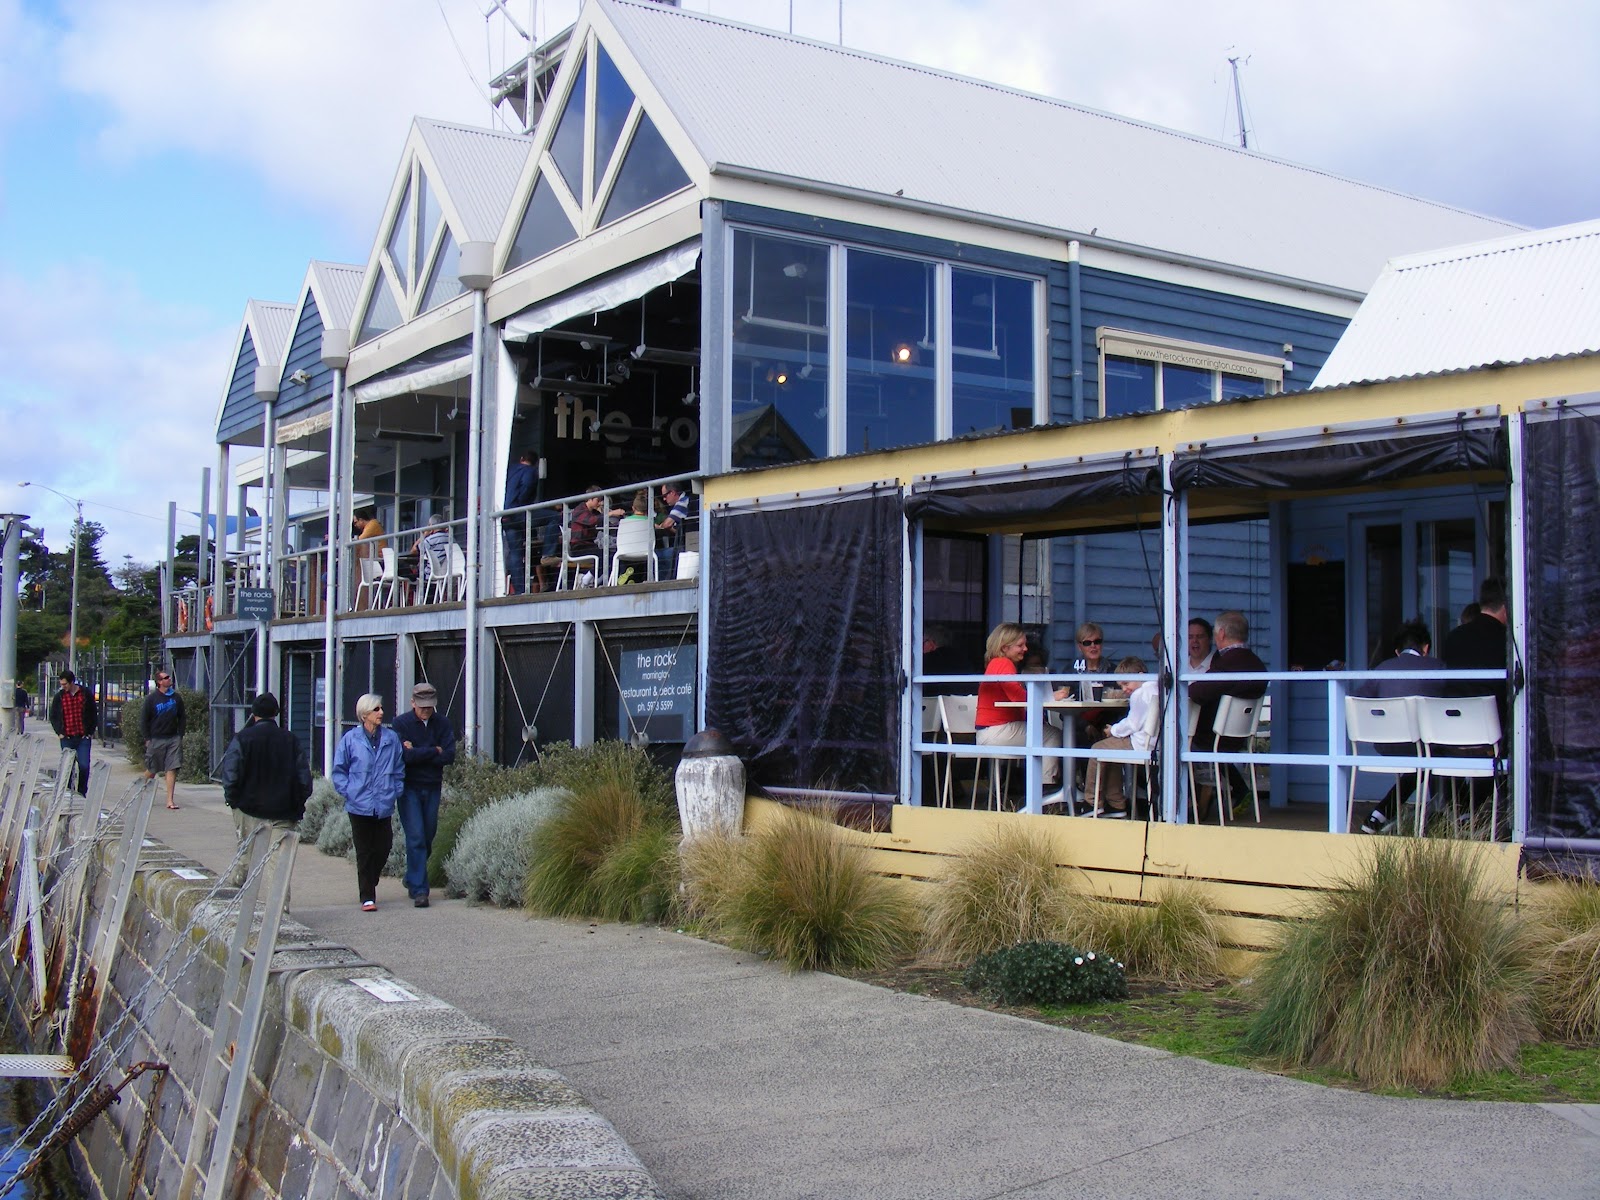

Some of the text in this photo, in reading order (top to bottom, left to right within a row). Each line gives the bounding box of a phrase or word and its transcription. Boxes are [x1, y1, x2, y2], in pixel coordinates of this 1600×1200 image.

[1134, 348, 1258, 375] www.therocksmornington.com.au
[553, 392, 632, 443] the
[253, 591, 272, 599] rocks
[637, 651, 677, 668] the rocks
[1073, 659, 1086, 671] 44
[621, 686, 652, 698] restaurant
[653, 685, 658, 697] &
[676, 683, 692, 695] café
[660, 700, 674, 711] 5599
